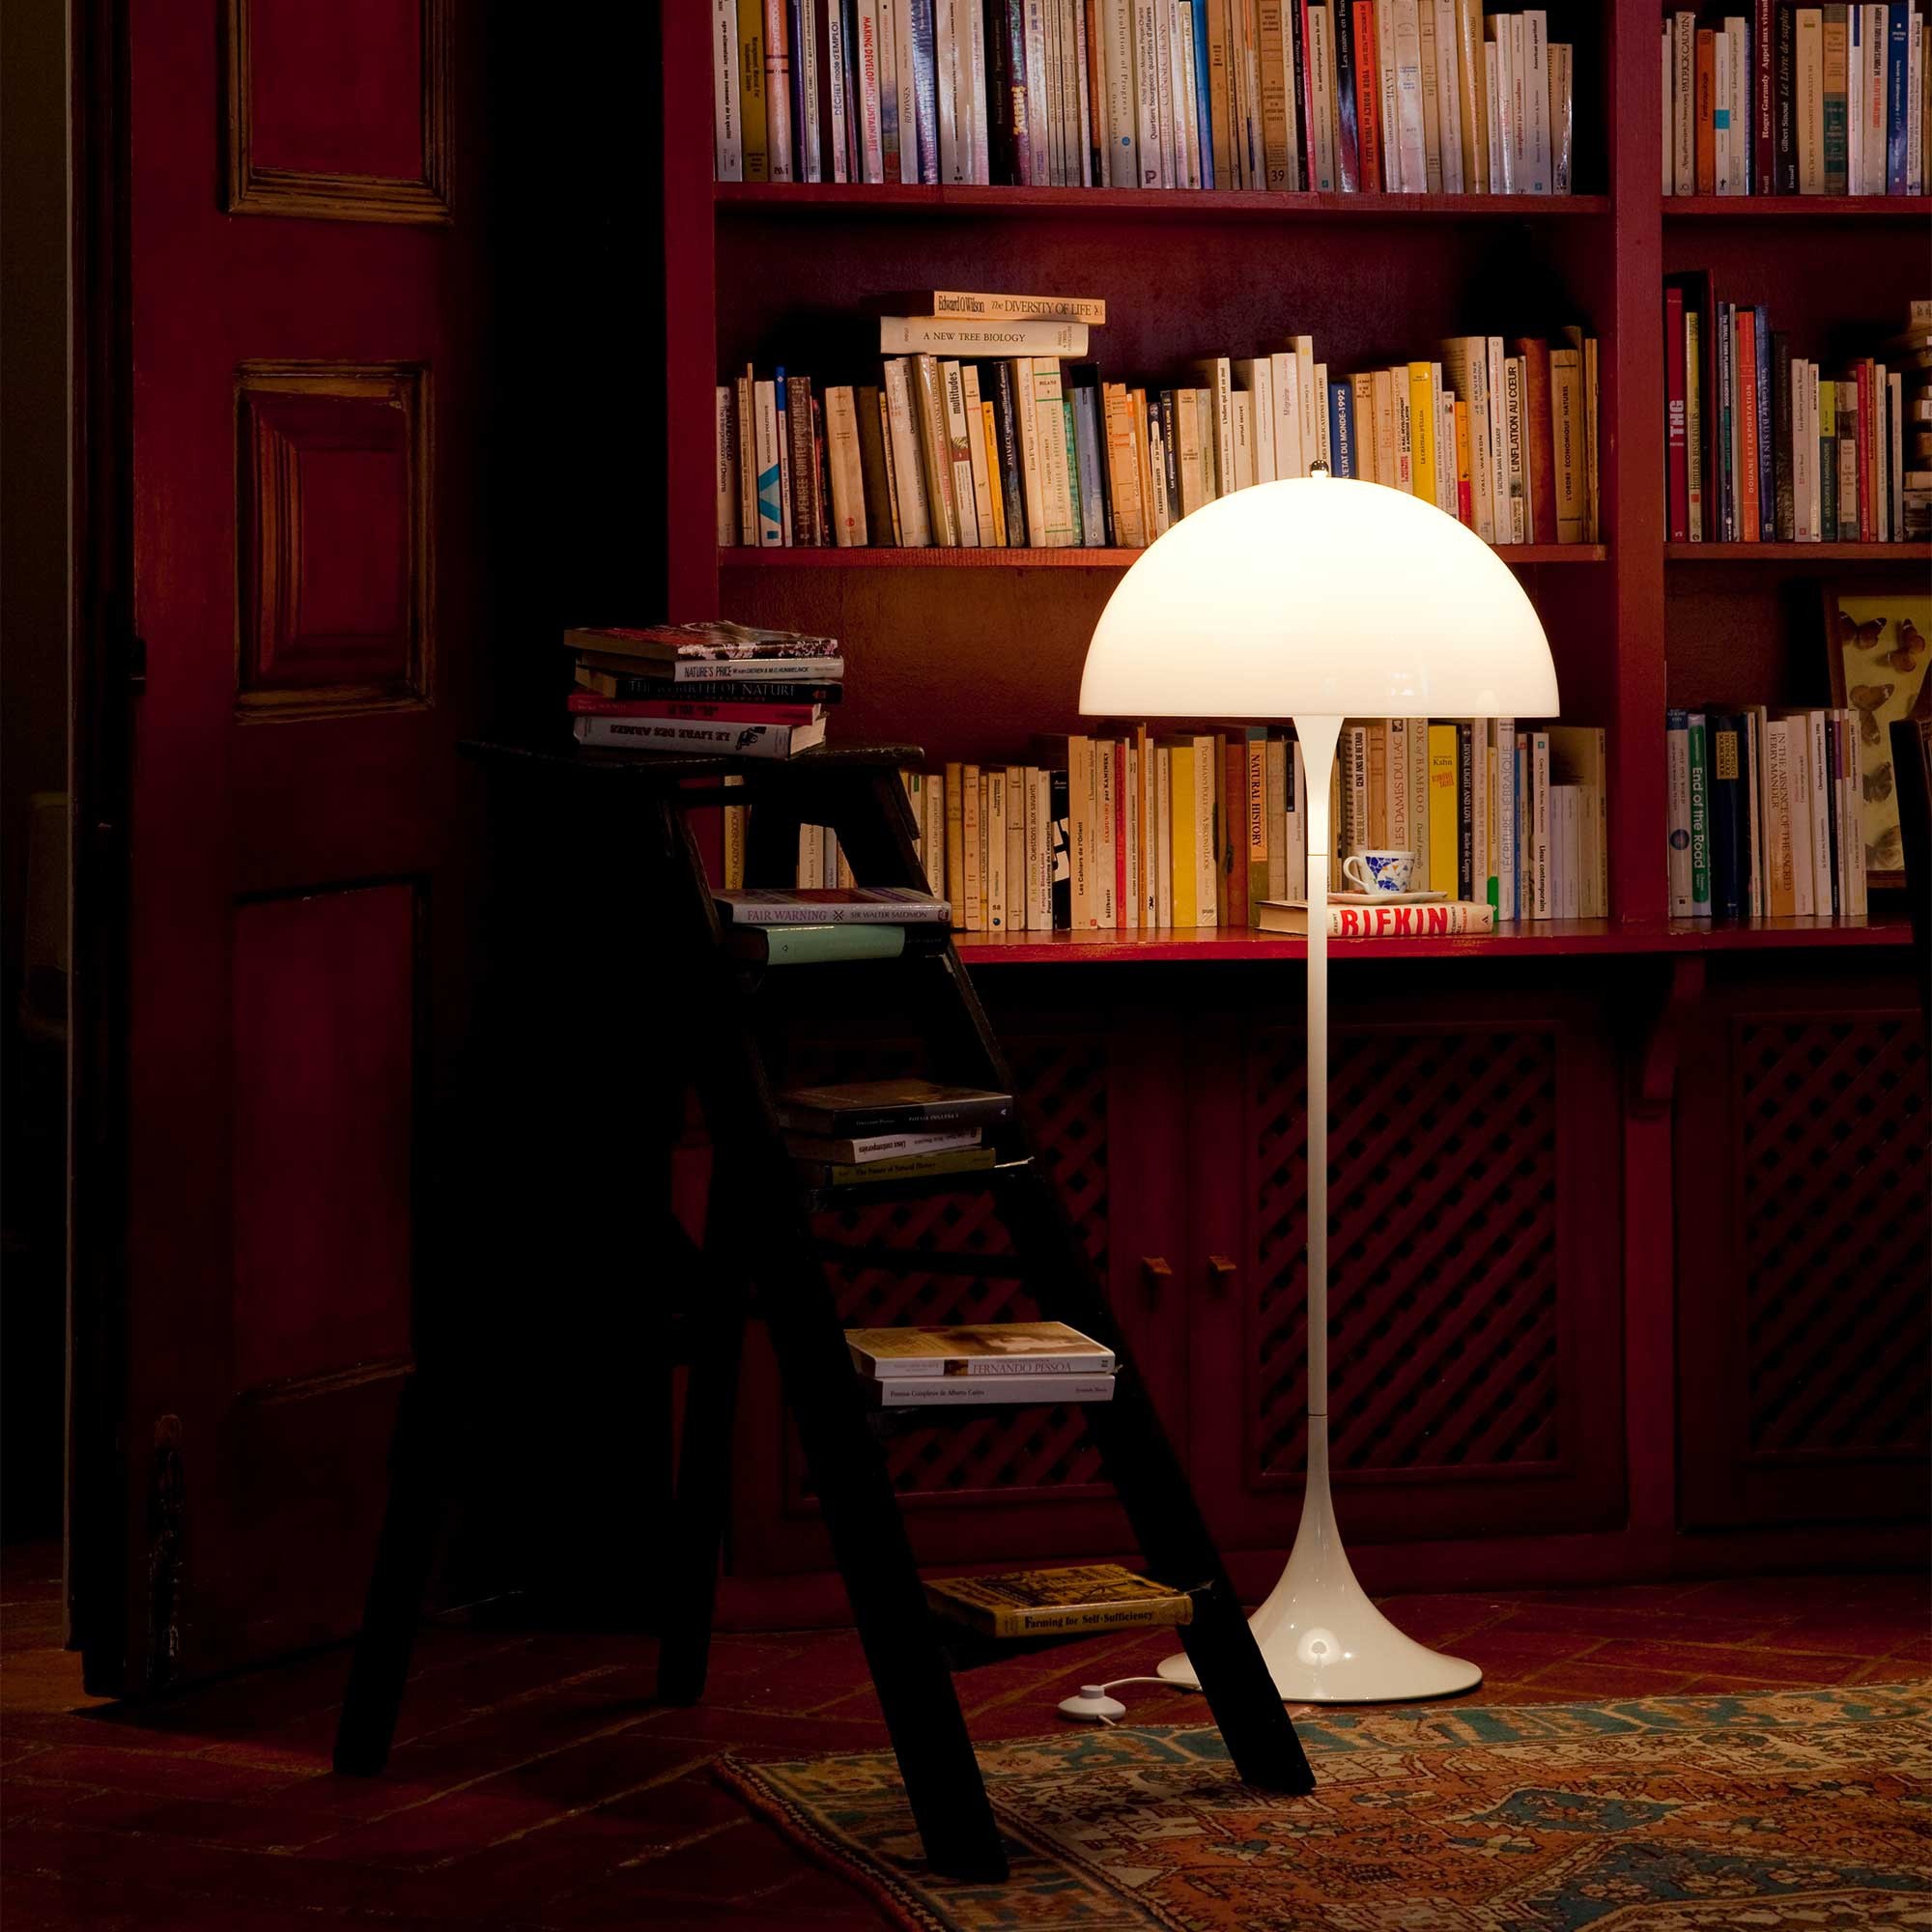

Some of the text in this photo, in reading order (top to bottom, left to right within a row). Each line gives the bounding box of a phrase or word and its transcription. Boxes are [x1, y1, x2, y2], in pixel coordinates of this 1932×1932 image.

[863, 16, 872, 48] MAKING
[1779, 8, 1790, 40] saphir
[1761, 44, 1770, 70] Appel
[1780, 42, 1788, 54] de
[1121, 61, 1128, 70] of
[1780, 56, 1789, 81] Livre
[1120, 73, 1128, 116] Progress
[1762, 74, 1771, 111] Garaudy
[1780, 83, 1789, 97] Le
[1150, 108, 1158, 140] Quartiers
[938, 296, 961, 312] Edward
[990, 300, 1004, 310] The
[1005, 299, 1054, 314] DIVERSITY
[1055, 304, 1069, 315] OF
[1070, 305, 1092, 317] LIFE
[933, 331, 955, 340] NEW
[958, 332, 980, 341] TREE
[982, 332, 1026, 342] BIOLOGY
[948, 371, 962, 414] multitudes
[1282, 387, 1293, 416] Migraine
[1508, 366, 1520, 472] L'INFLATION AU CŒUR
[1669, 400, 1685, 438] THG
[1746, 384, 1754, 444] EXPORTATION
[793, 401, 808, 476] CONTEMPORAINE
[1337, 388, 1350, 478] L'ETAT DU MONDE-1992
[1563, 420, 1572, 468] ÉCONOMIQUE
[1762, 418, 1771, 474] BUSINESS
[1747, 447, 1753, 457] ET
[684, 666, 732, 678] NATURE'S PRICE
[654, 726, 675, 738] DES
[678, 728, 713, 740] LIVRE
[1354, 732, 1363, 753] RETARD
[1433, 757, 1453, 766] Kahn
[1463, 743, 1471, 768] DIVINE
[1355, 773, 1364, 787] CENT
[1769, 732, 1779, 810] JERRY MANDER
[1251, 754, 1262, 847] NATURAL HISTORY
[1393, 736, 1405, 846] LES DAMES DU LAC
[1499, 745, 1513, 873] L'ÉCRITURE HÉBRAÏQUE
[1692, 767, 1705, 868] End of the Road
[1777, 732, 1792, 891] IN THE ABSENCE OF THE SACRED
[1077, 847, 1083, 856] de
[748, 910, 827, 921] FAIR WARNING
[890, 910, 928, 919] SALOMON
[1340, 907, 1449, 936] RIFKIN
[973, 1362, 1072, 1375] FERNANDO PESSOA
[1025, 1615, 1078, 1631] Farming for
